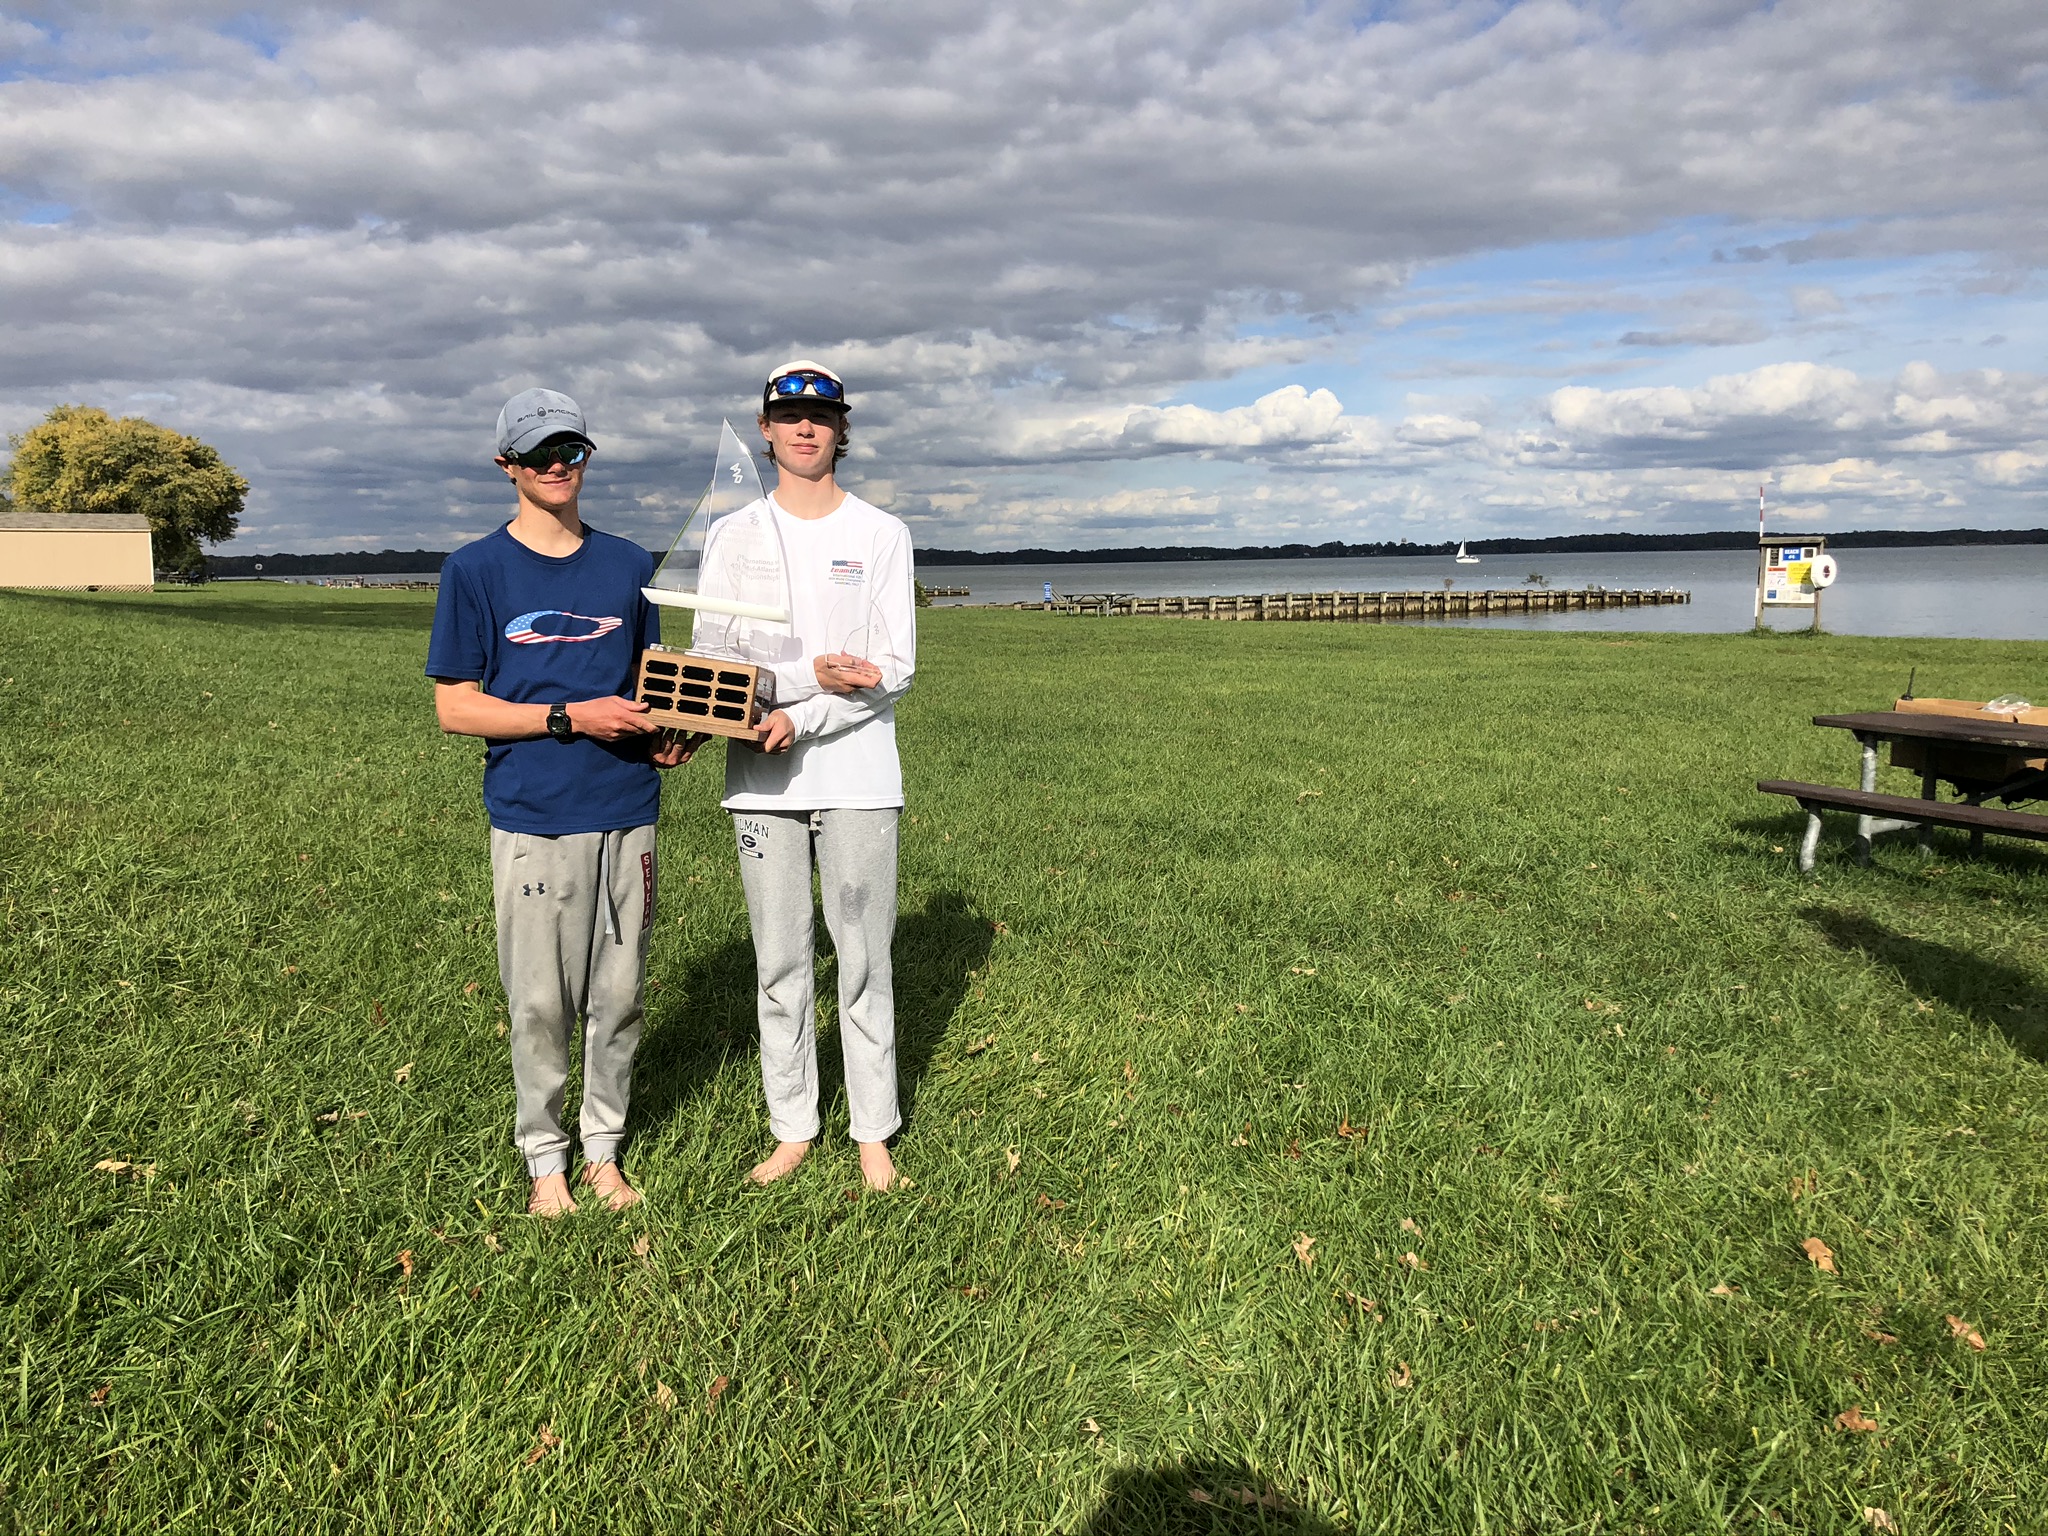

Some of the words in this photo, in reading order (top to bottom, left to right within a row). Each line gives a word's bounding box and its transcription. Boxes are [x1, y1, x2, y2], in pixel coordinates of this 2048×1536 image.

[517, 413, 537, 423] SAIL
[547, 408, 578, 418] RACING
[729, 462, 744, 484] 420
